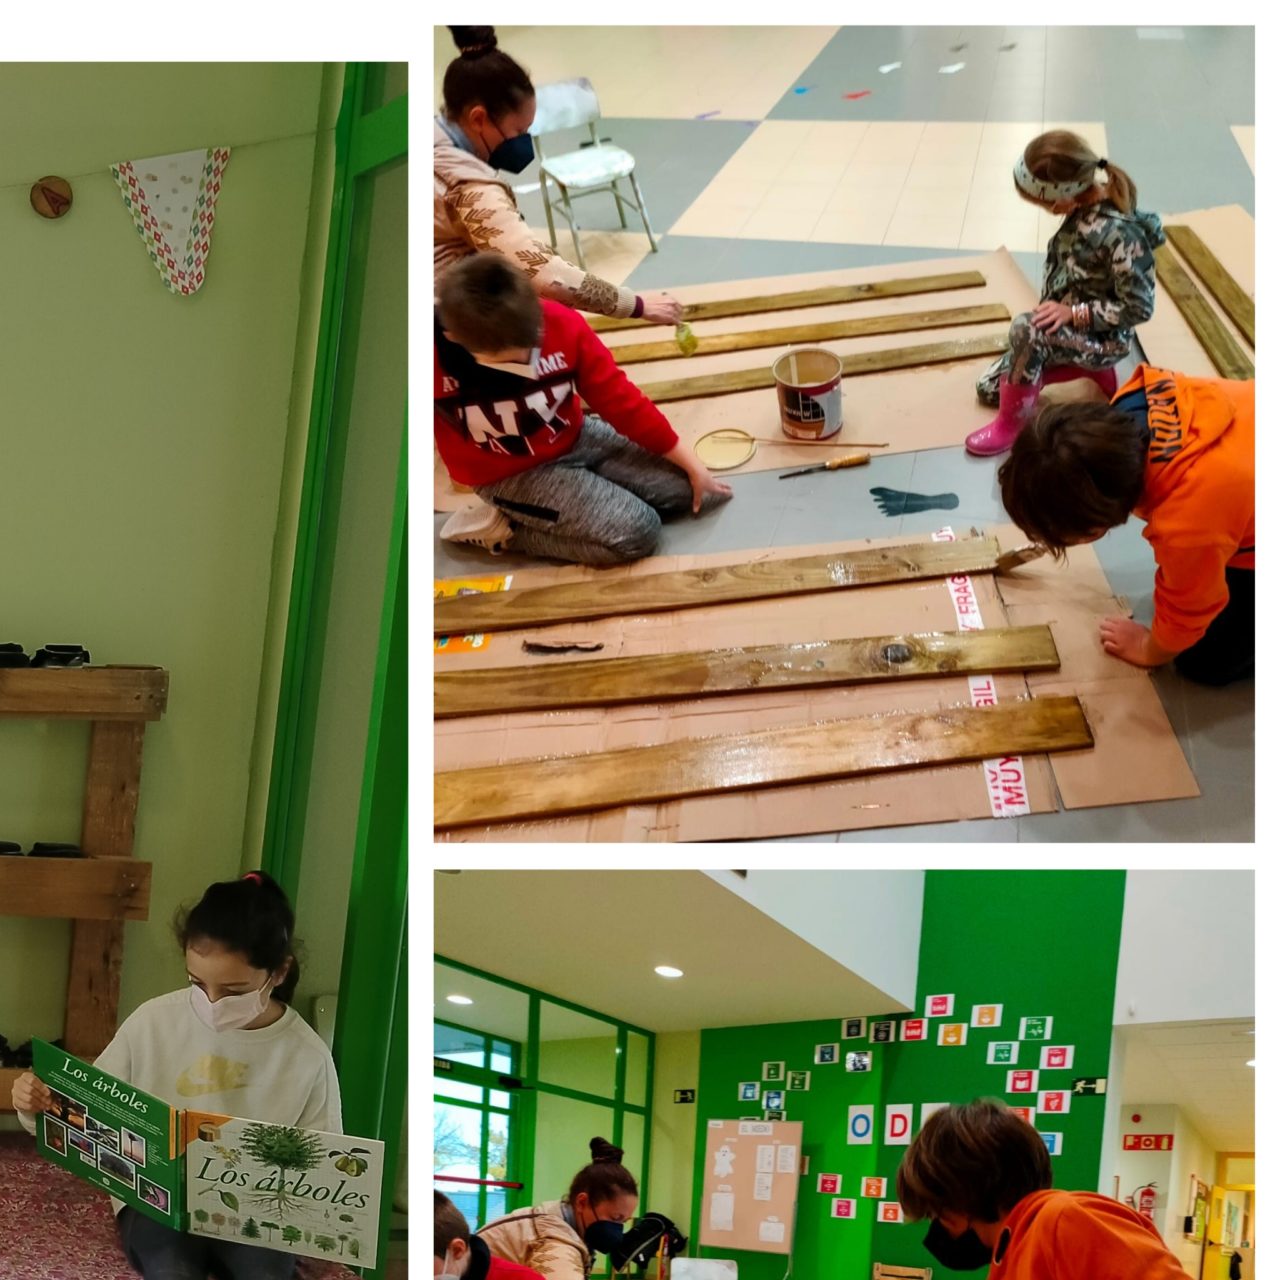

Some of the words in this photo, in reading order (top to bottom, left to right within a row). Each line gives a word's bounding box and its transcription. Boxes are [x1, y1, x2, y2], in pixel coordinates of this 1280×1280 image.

[536, 352, 568, 376] IME
[458, 382, 572, 444] NY
[951, 575, 970, 616] FRAG
[974, 680, 995, 707] GIL
[62, 1057, 88, 1082] Los
[93, 1075, 149, 1114] árboles
[851, 1113, 908, 1138] OD
[195, 1156, 248, 1189] Los
[256, 1165, 371, 1210] árboles
